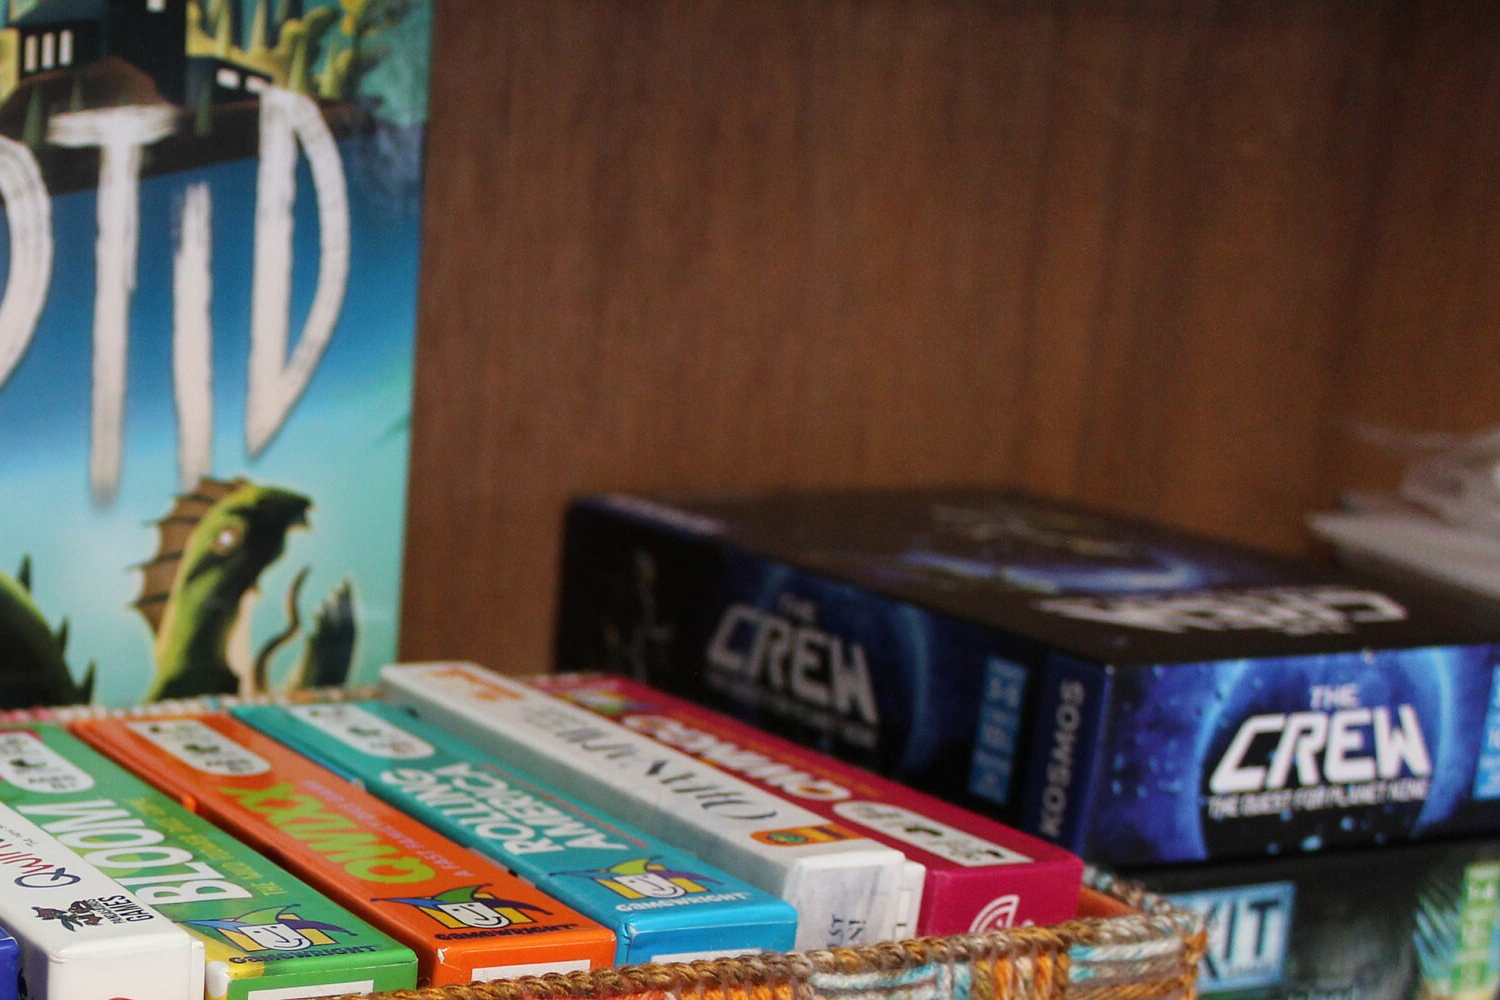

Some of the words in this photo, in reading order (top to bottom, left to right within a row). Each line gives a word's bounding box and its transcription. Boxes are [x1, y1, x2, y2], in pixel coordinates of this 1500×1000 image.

[707, 602, 880, 727] CREW
[1309, 683, 1360, 710] THE
[1039, 679, 1086, 838] KOSMOS
[1208, 703, 1432, 796] CREW
[217, 783, 437, 884] QWIXX
[380, 767, 565, 855] ROLLING
[434, 762, 631, 851] AMERICA
[16, 800, 253, 905] BLOOM
[97, 894, 155, 923] GAMES
[435, 923, 573, 943] GAMEWRIGHT
[614, 891, 746, 914] GAMEWRIGHT
[228, 944, 377, 965] GAMEWRIGHT
